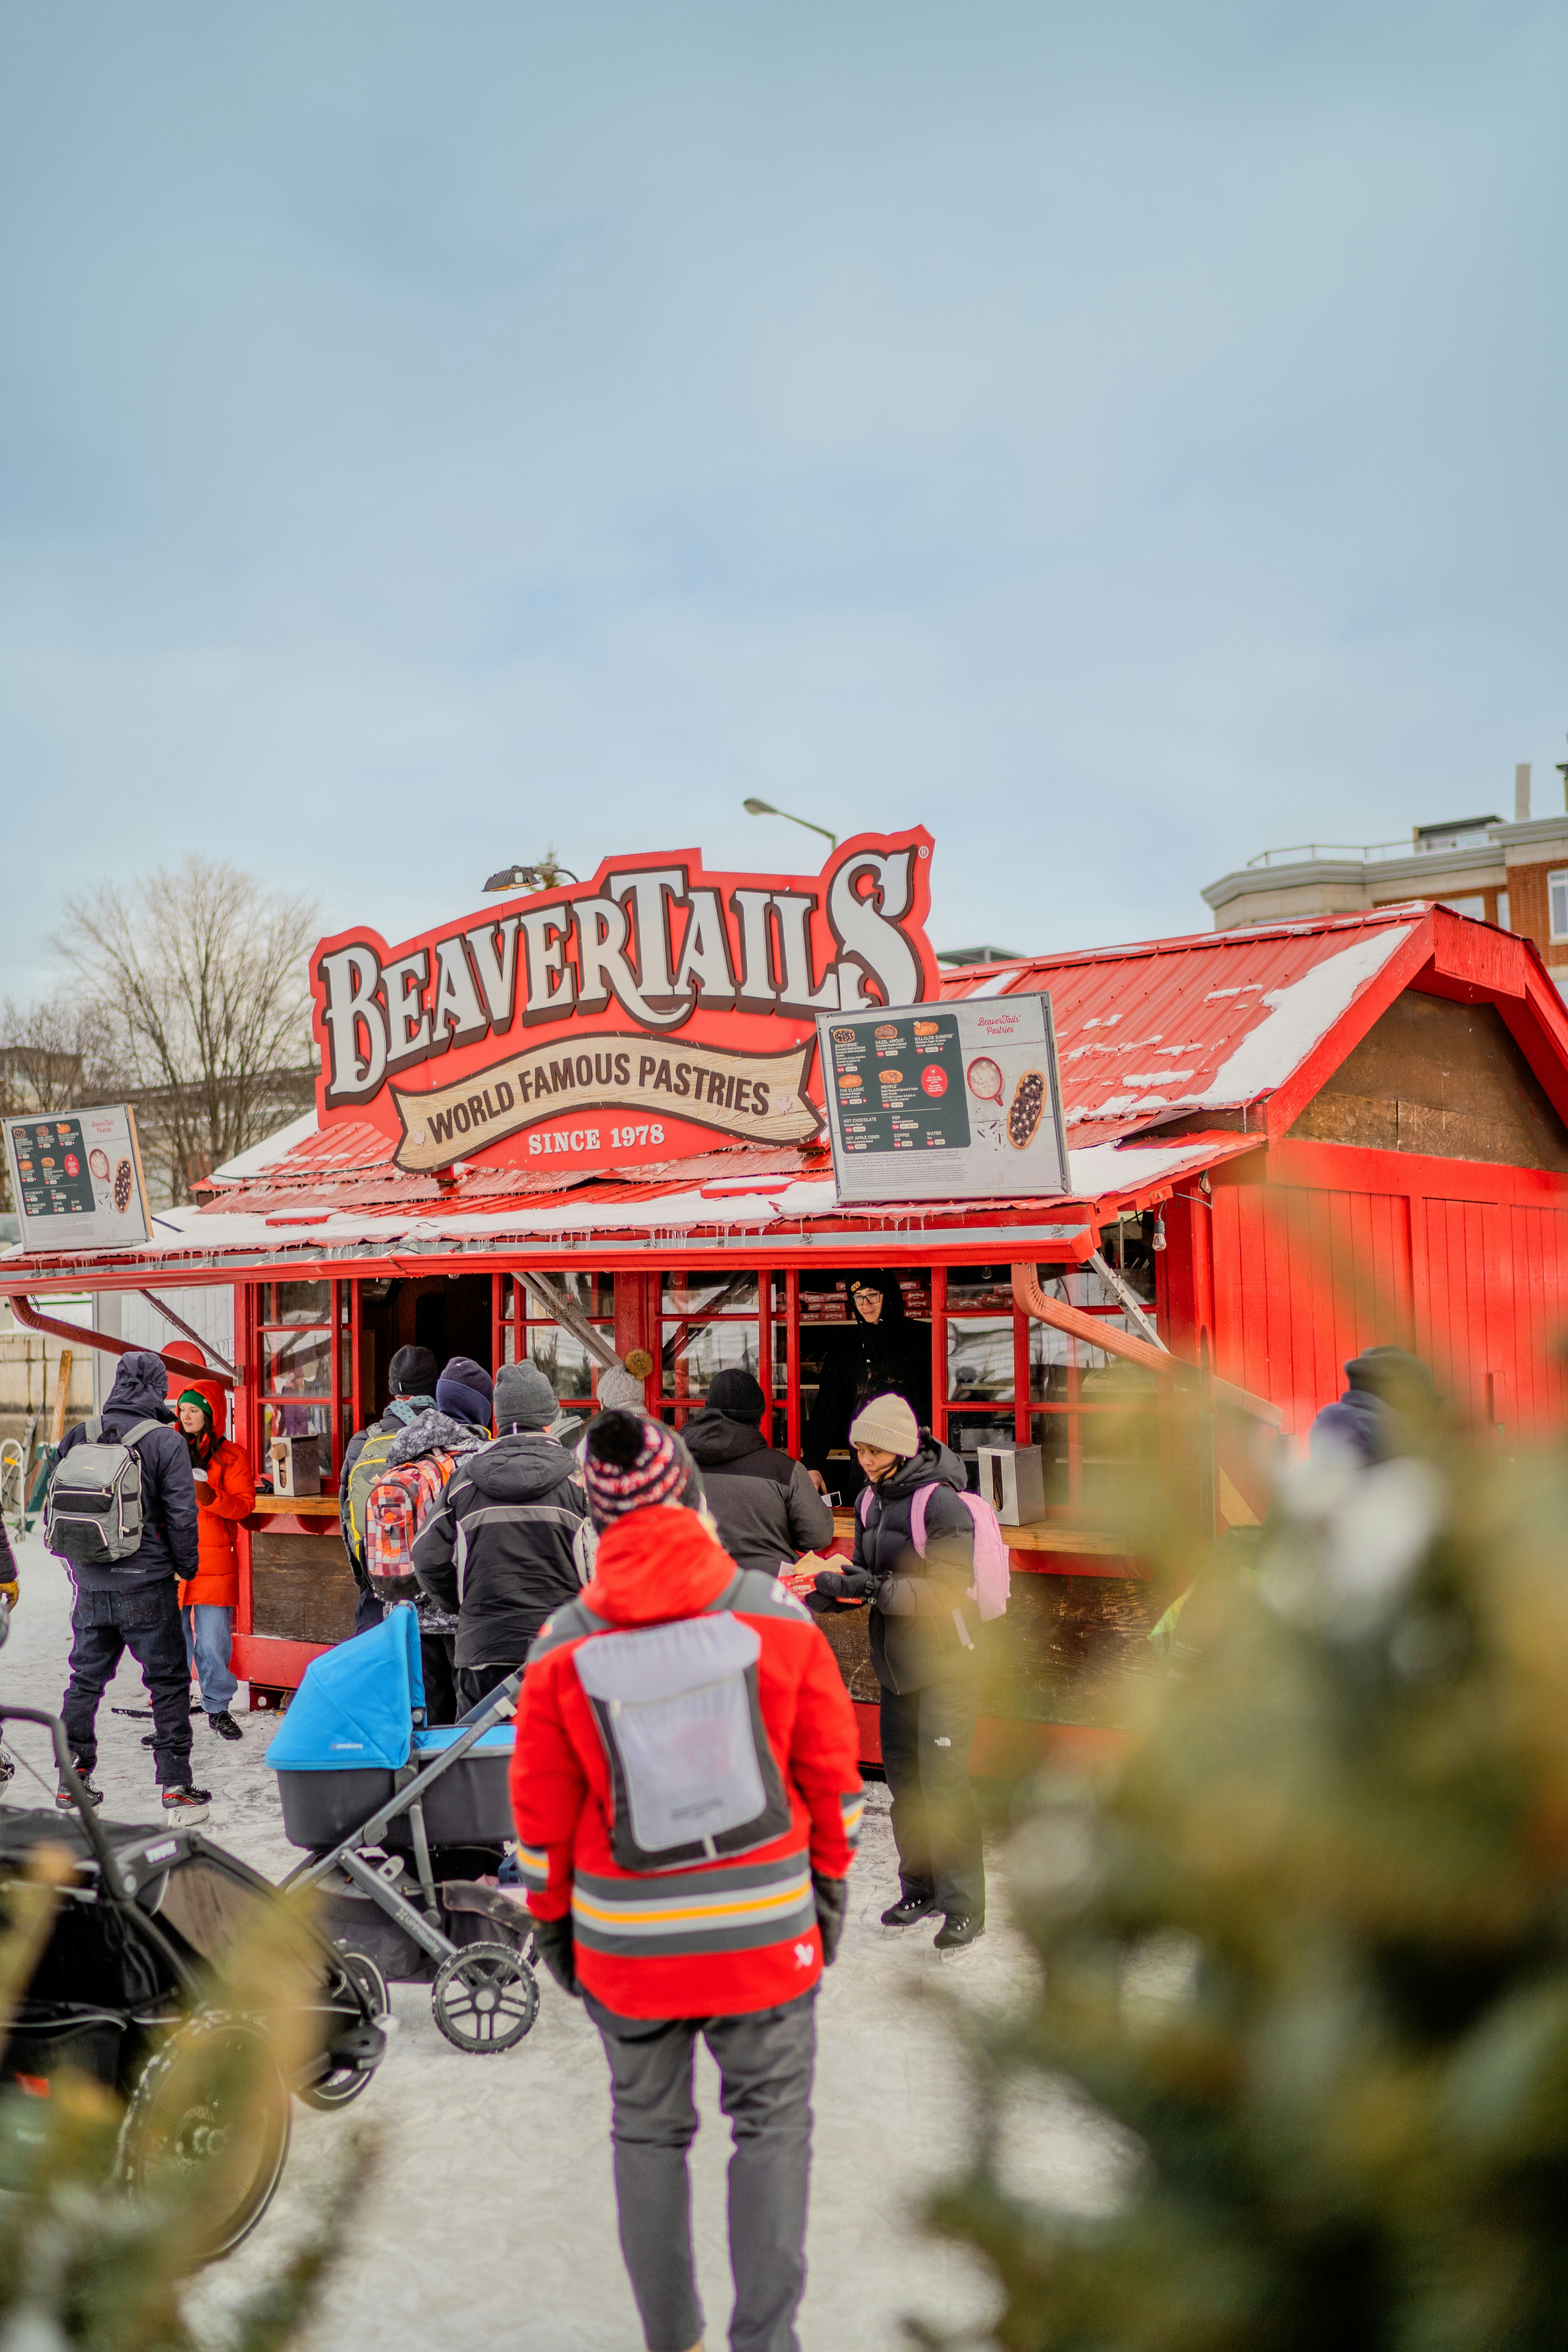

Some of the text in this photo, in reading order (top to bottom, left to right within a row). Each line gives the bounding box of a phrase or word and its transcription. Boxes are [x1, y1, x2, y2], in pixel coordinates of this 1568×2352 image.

[987, 1026, 1014, 1035] Pastries
[427, 1053, 770, 1144] WORLD FAMOUS PASTRIES
[529, 1124, 665, 1155] SINCE 1978
[465, 1722, 489, 1744] VISTA
[145, 1840, 177, 1863] THULE
